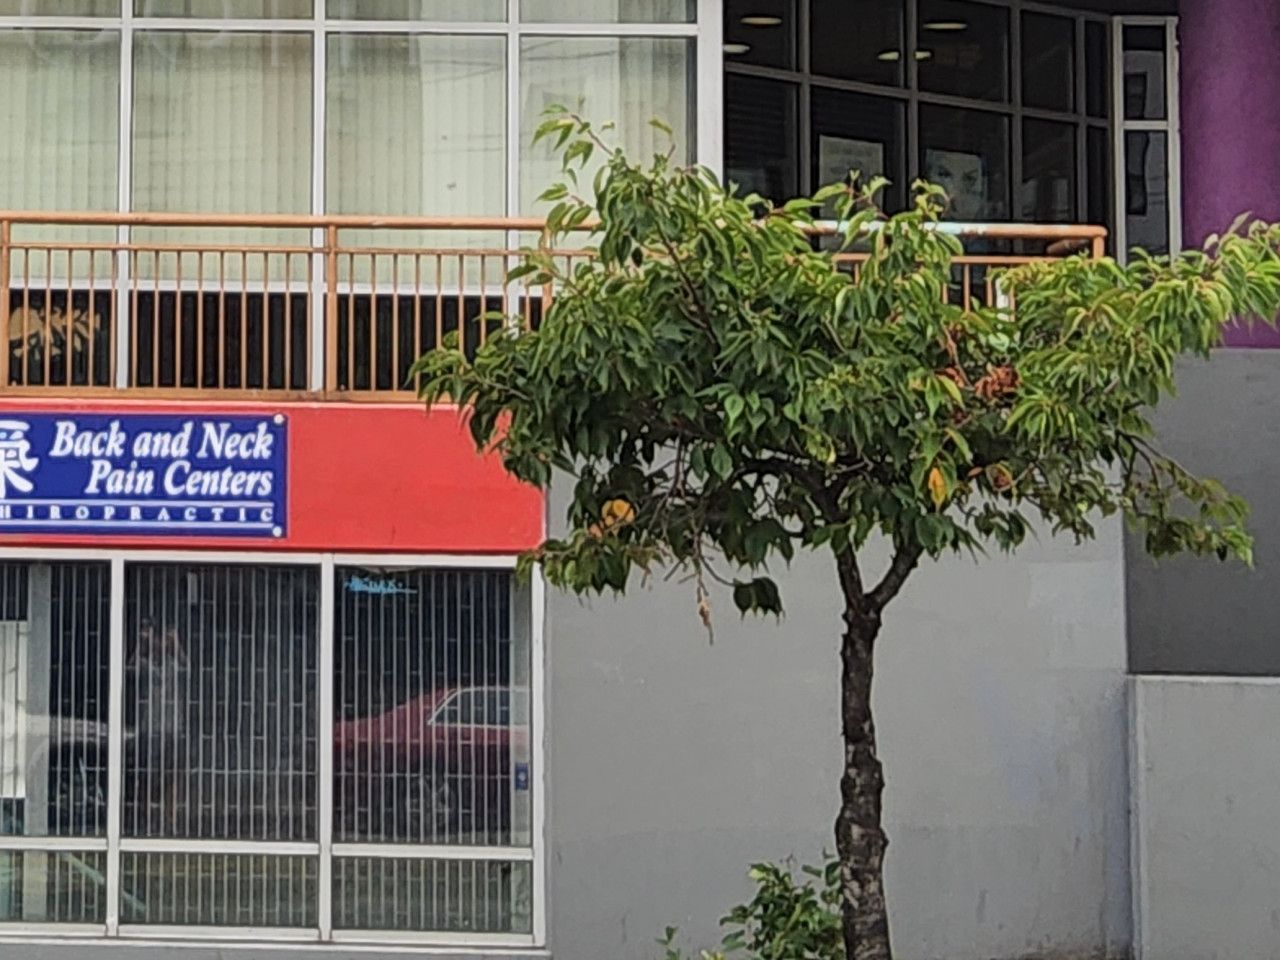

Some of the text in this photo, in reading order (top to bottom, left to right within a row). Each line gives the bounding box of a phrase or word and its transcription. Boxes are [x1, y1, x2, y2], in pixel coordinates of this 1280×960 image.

[49, 420, 273, 459] Back and Neck
[84, 460, 274, 497] Pain Centers
